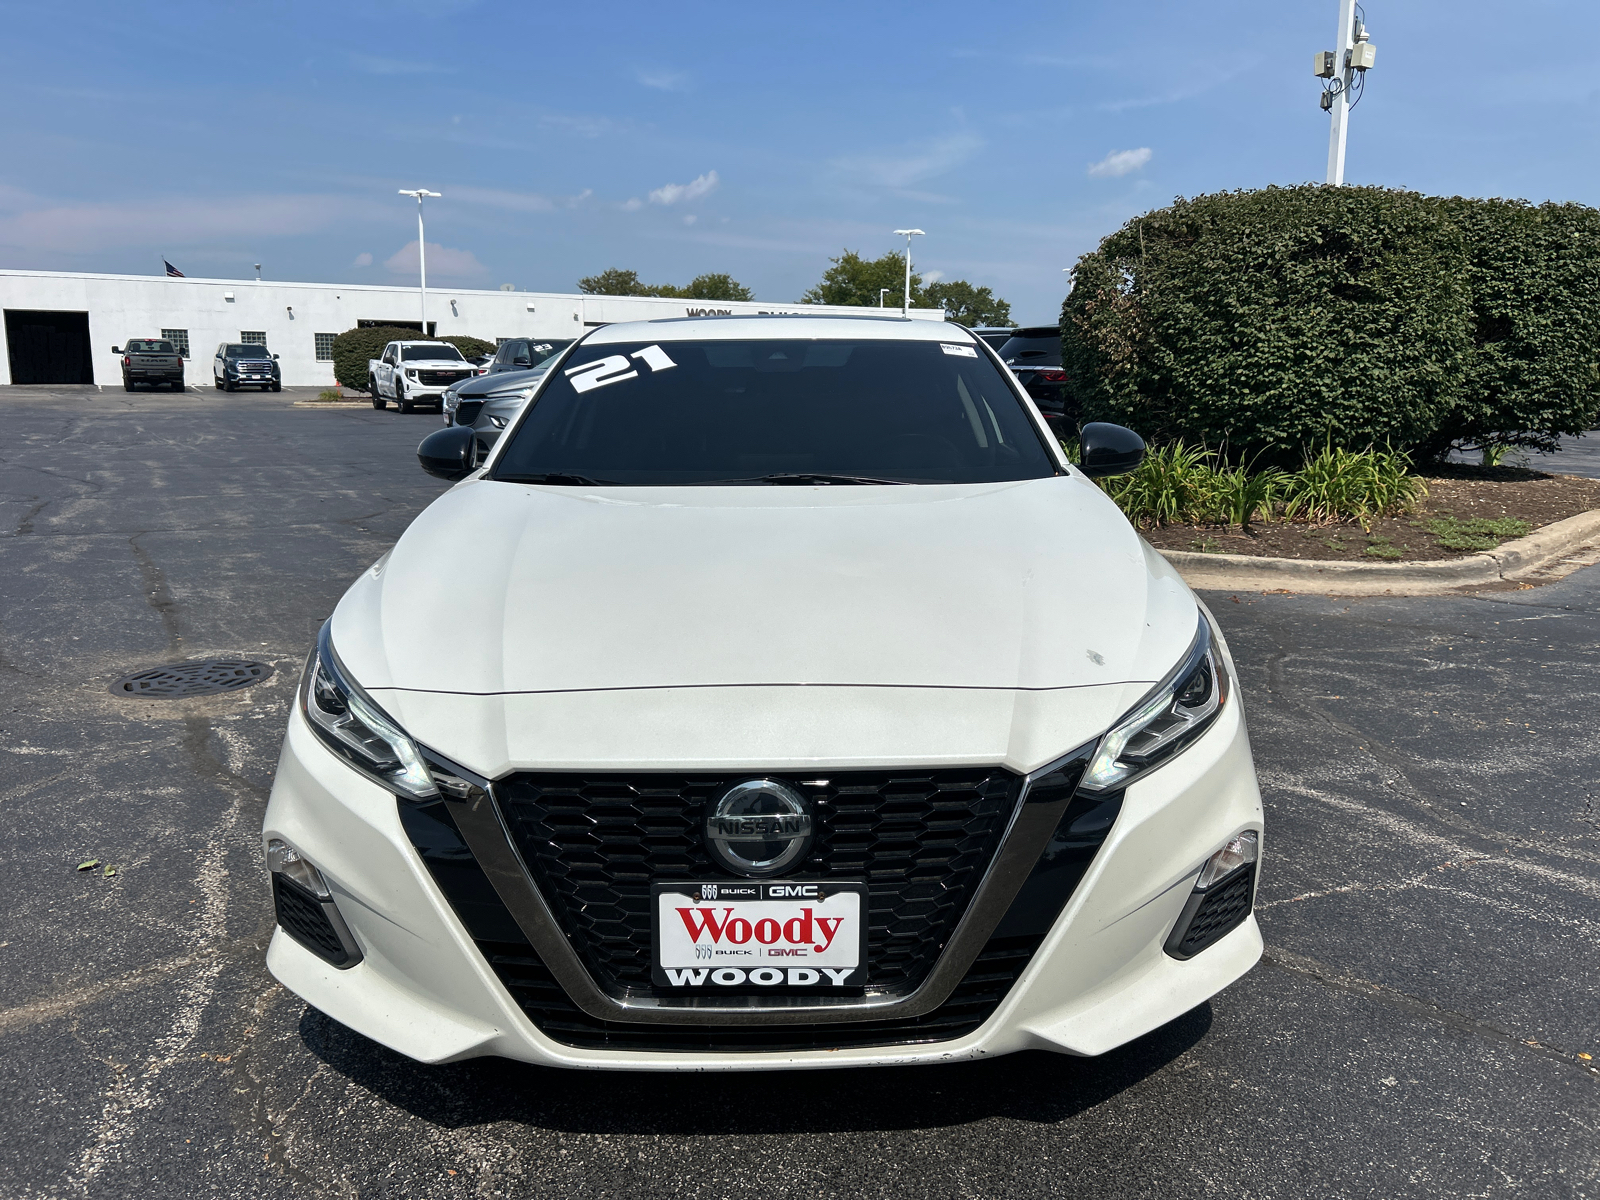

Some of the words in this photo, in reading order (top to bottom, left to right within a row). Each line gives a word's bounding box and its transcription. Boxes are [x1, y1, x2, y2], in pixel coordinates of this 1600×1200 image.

[564, 344, 678, 393] 21
[718, 820, 800, 835] NISSAN
[769, 885, 818, 897] GMC
[675, 907, 844, 953] Woody
[768, 948, 808, 957] GMC
[664, 967, 855, 986] WOODY
